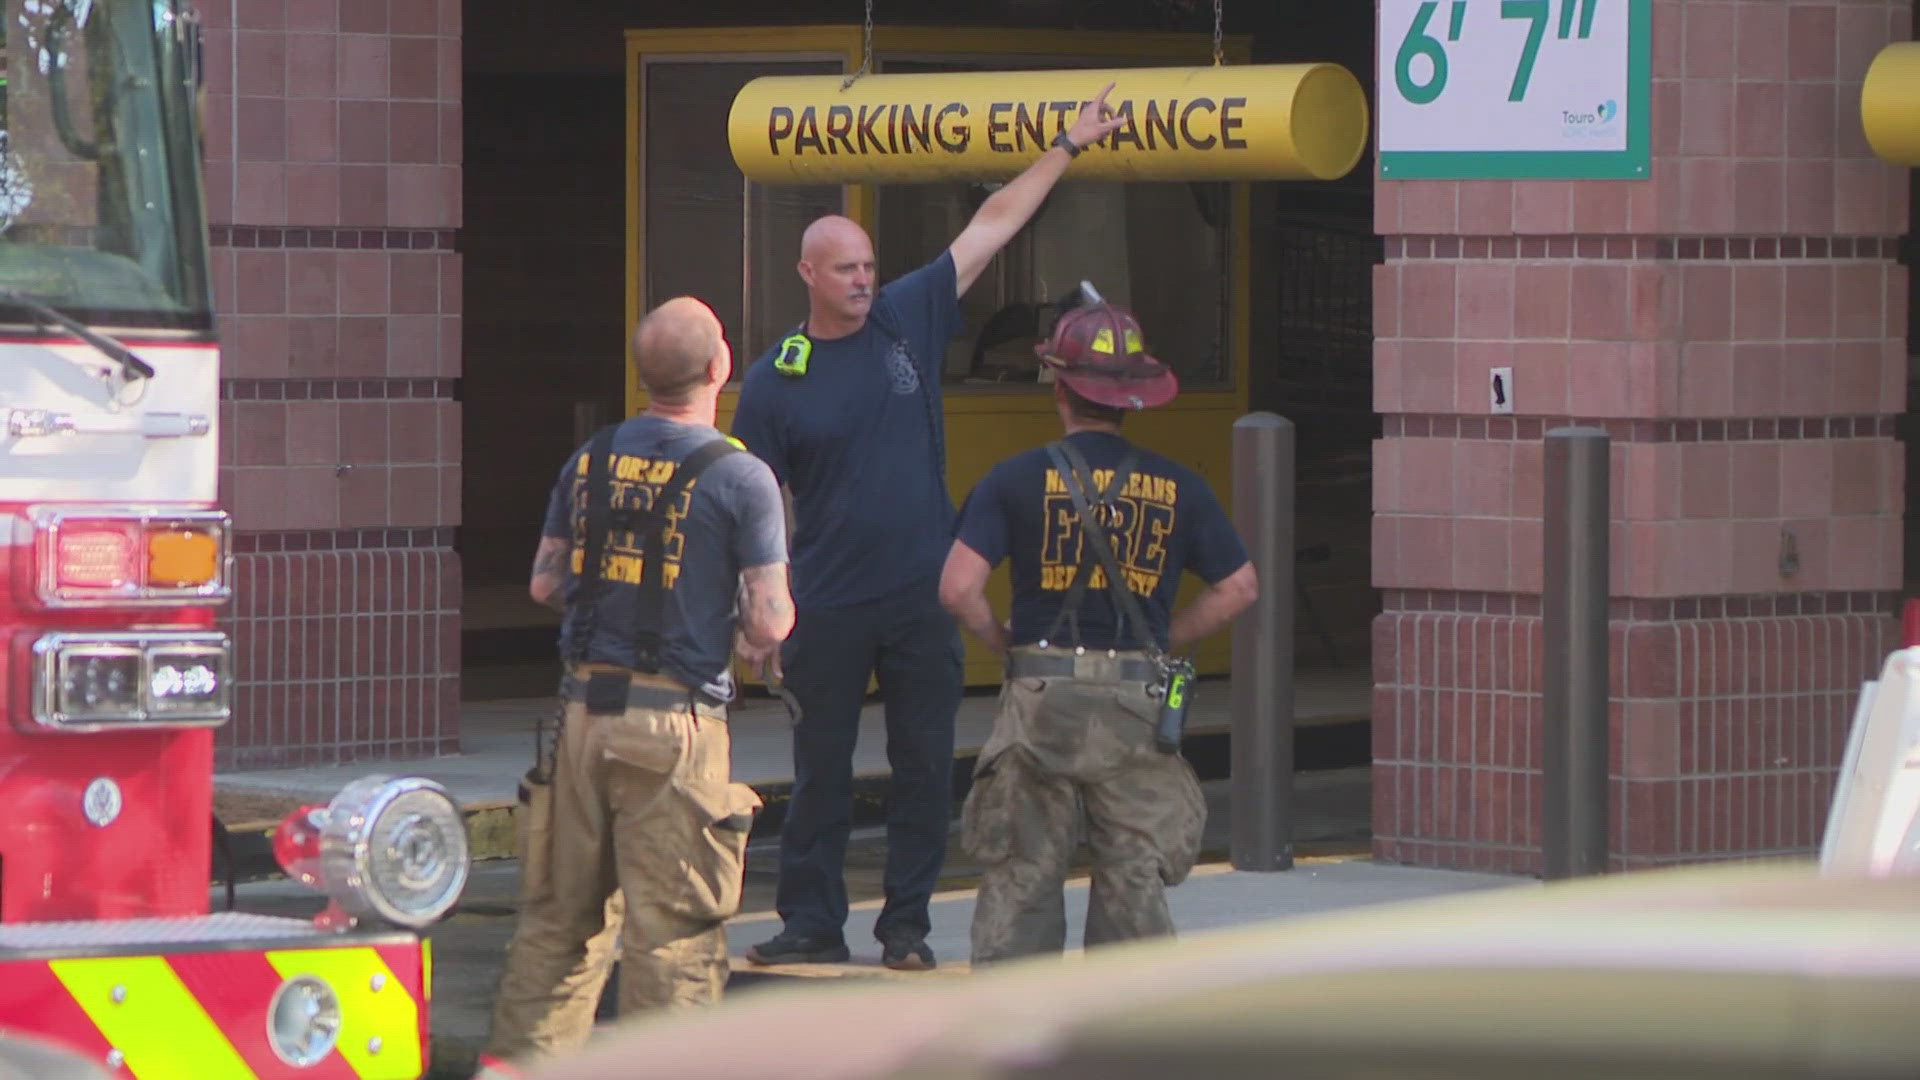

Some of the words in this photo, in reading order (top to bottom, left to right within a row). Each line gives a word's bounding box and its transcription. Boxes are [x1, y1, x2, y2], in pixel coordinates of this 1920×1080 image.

[768, 103, 971, 156] PARKING
[988, 98, 1248, 153] ENTANCE
[1562, 111, 1595, 124] Touro
